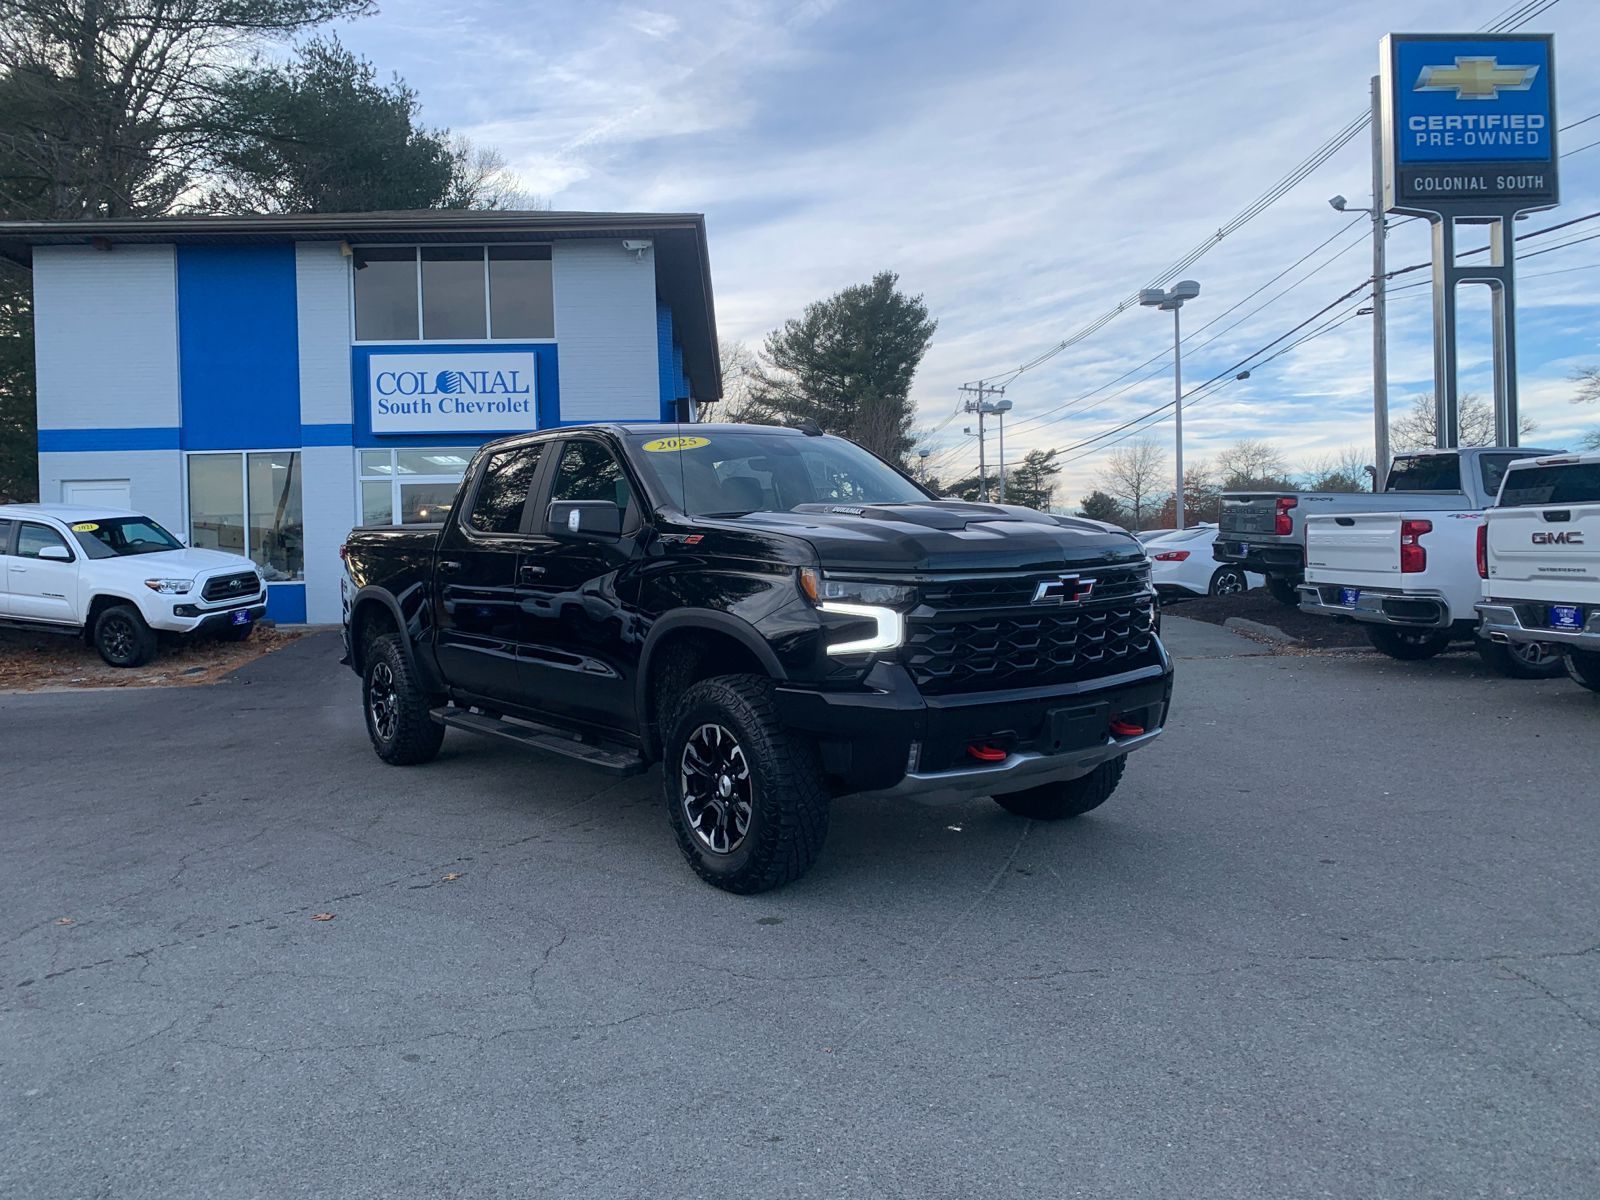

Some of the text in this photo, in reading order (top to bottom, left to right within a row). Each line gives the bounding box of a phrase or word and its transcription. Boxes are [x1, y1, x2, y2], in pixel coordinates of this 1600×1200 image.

[1408, 114, 1545, 131] CERTIFIED
[1416, 131, 1539, 146] PRE-OWNED
[1414, 175, 1544, 191] COLONIAL SOUTH
[376, 370, 530, 396] COLONIAL
[378, 397, 530, 414] South Chevrolet
[657, 437, 698, 450] 2025
[1222, 508, 1272, 516] CHEVROLET
[1309, 536, 1391, 545] CHEVROLET
[1531, 531, 1584, 545] GMC
